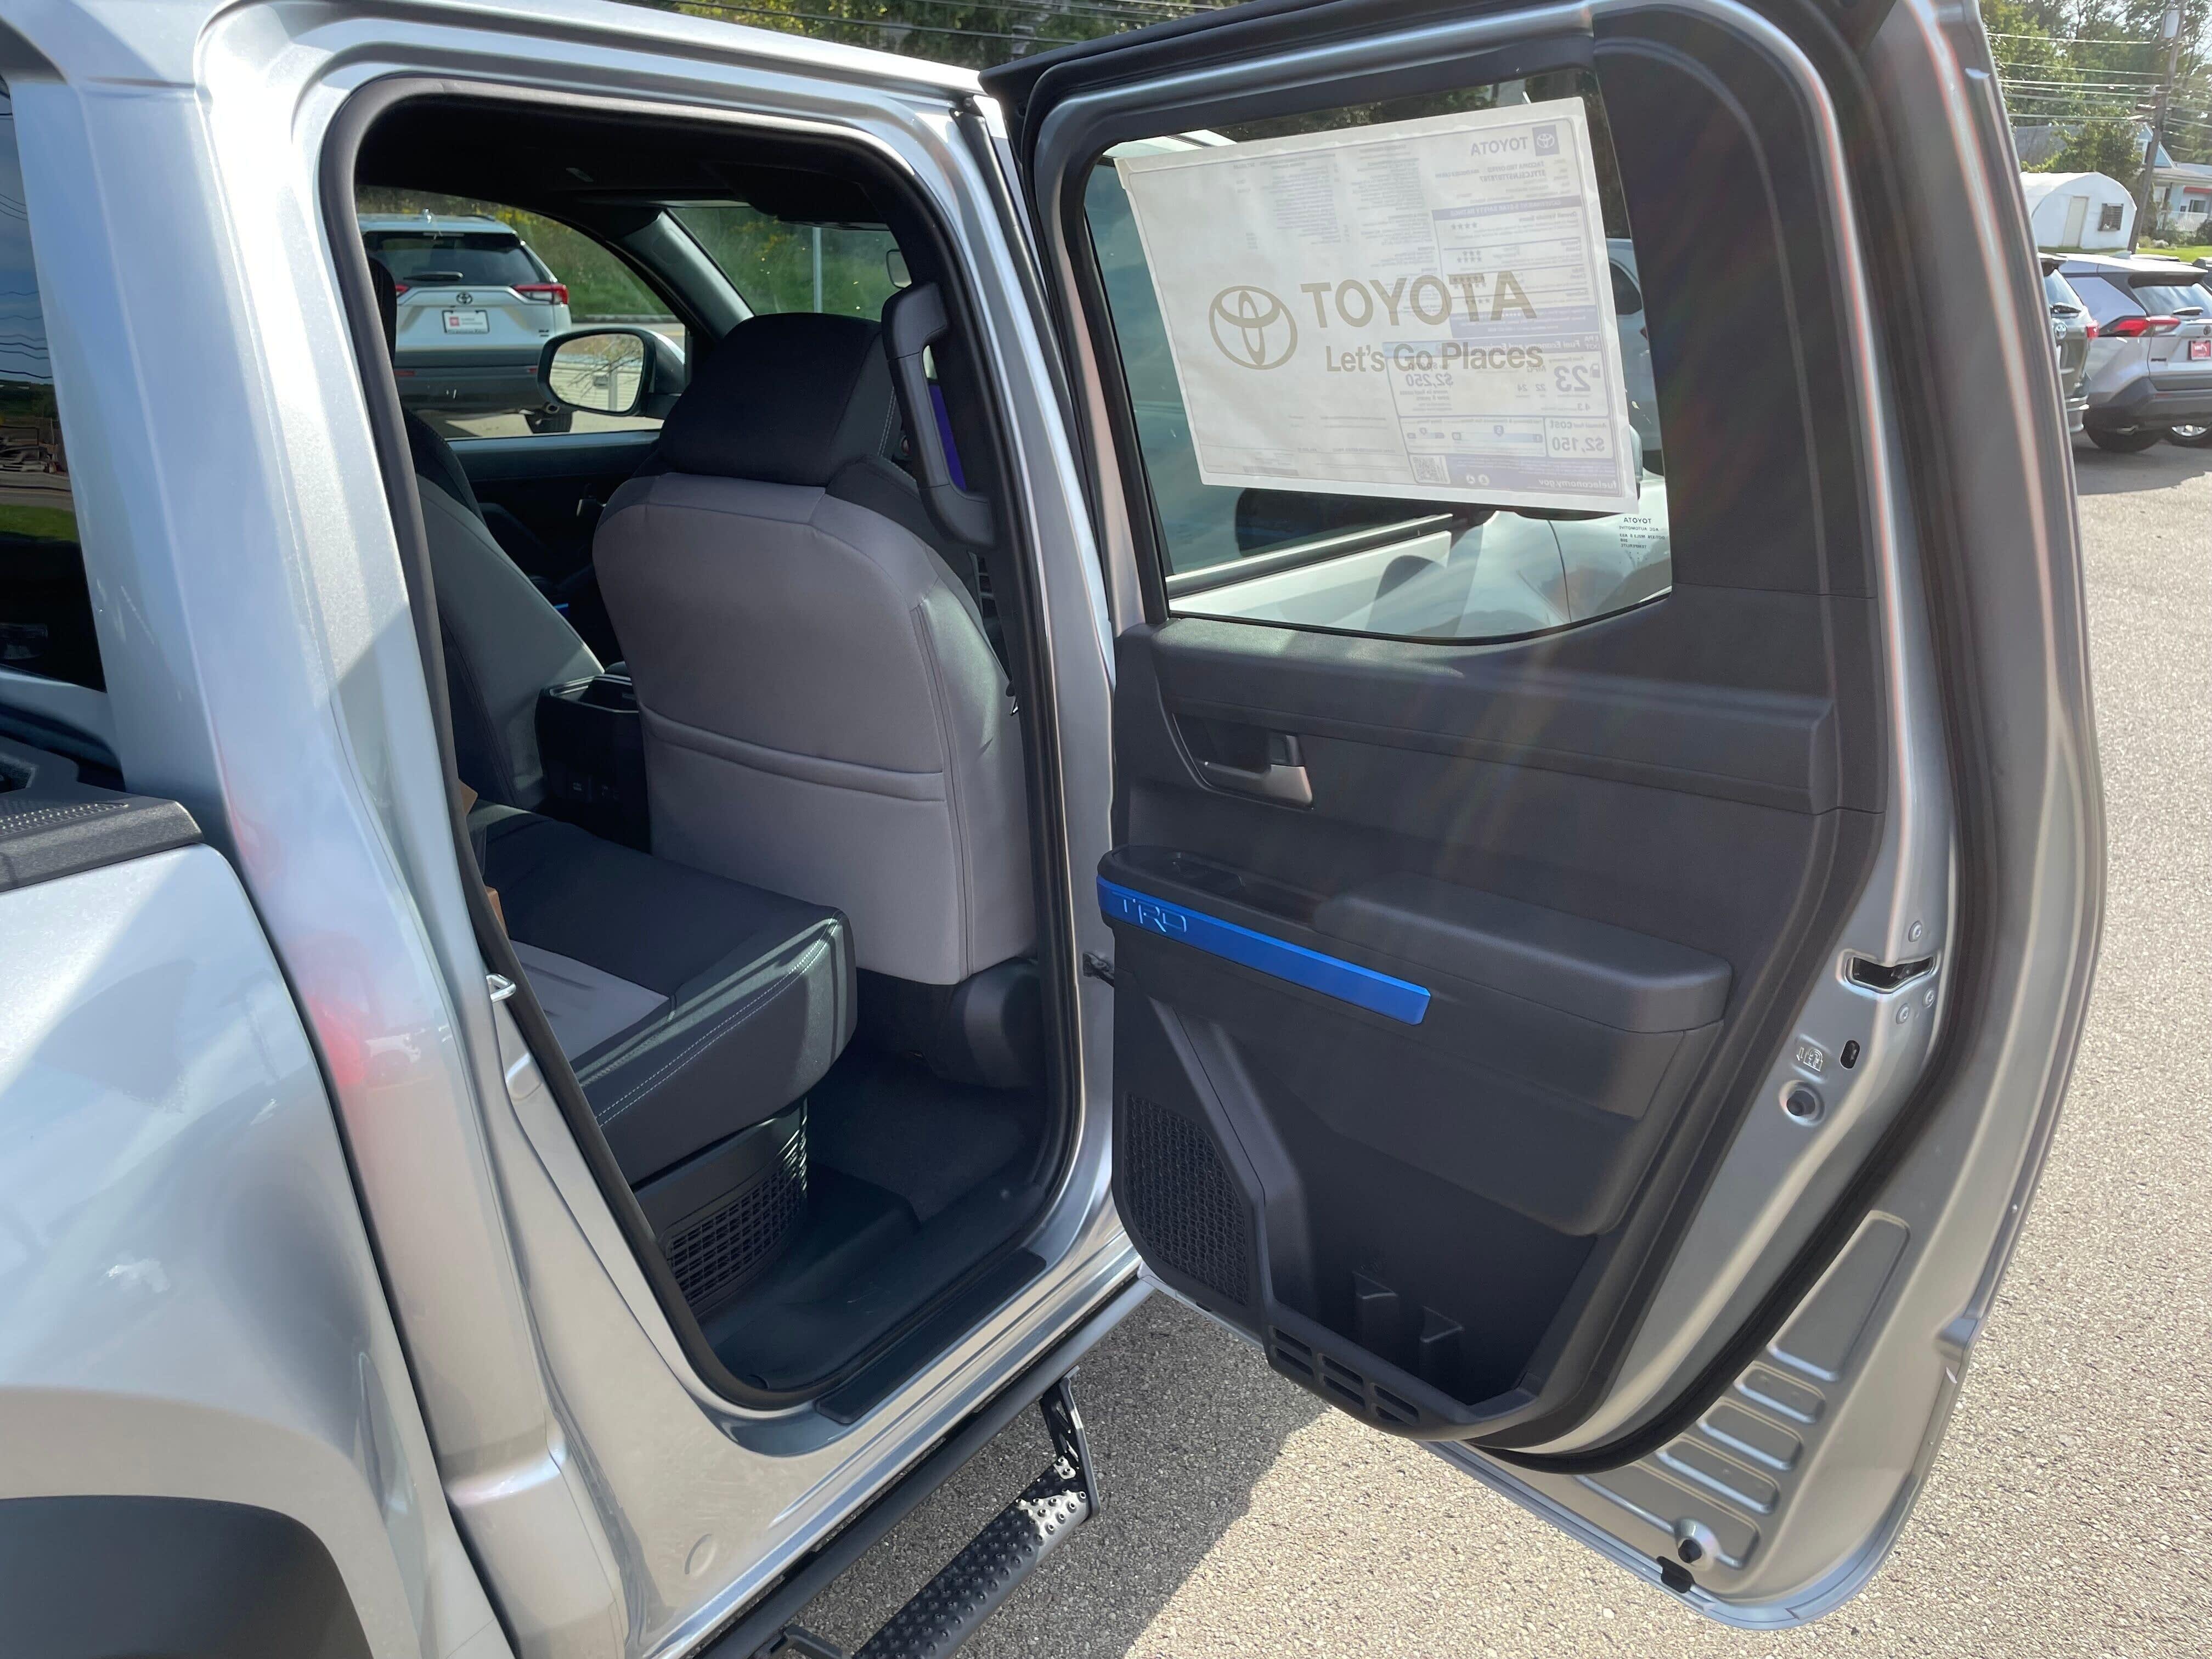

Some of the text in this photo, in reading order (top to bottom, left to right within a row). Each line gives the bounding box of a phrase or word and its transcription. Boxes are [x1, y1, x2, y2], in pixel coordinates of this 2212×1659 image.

[1300, 270, 1537, 328] TOYOTA
[1325, 342, 1544, 373] Let's Go Places
[1112, 890, 1187, 933] TRD
